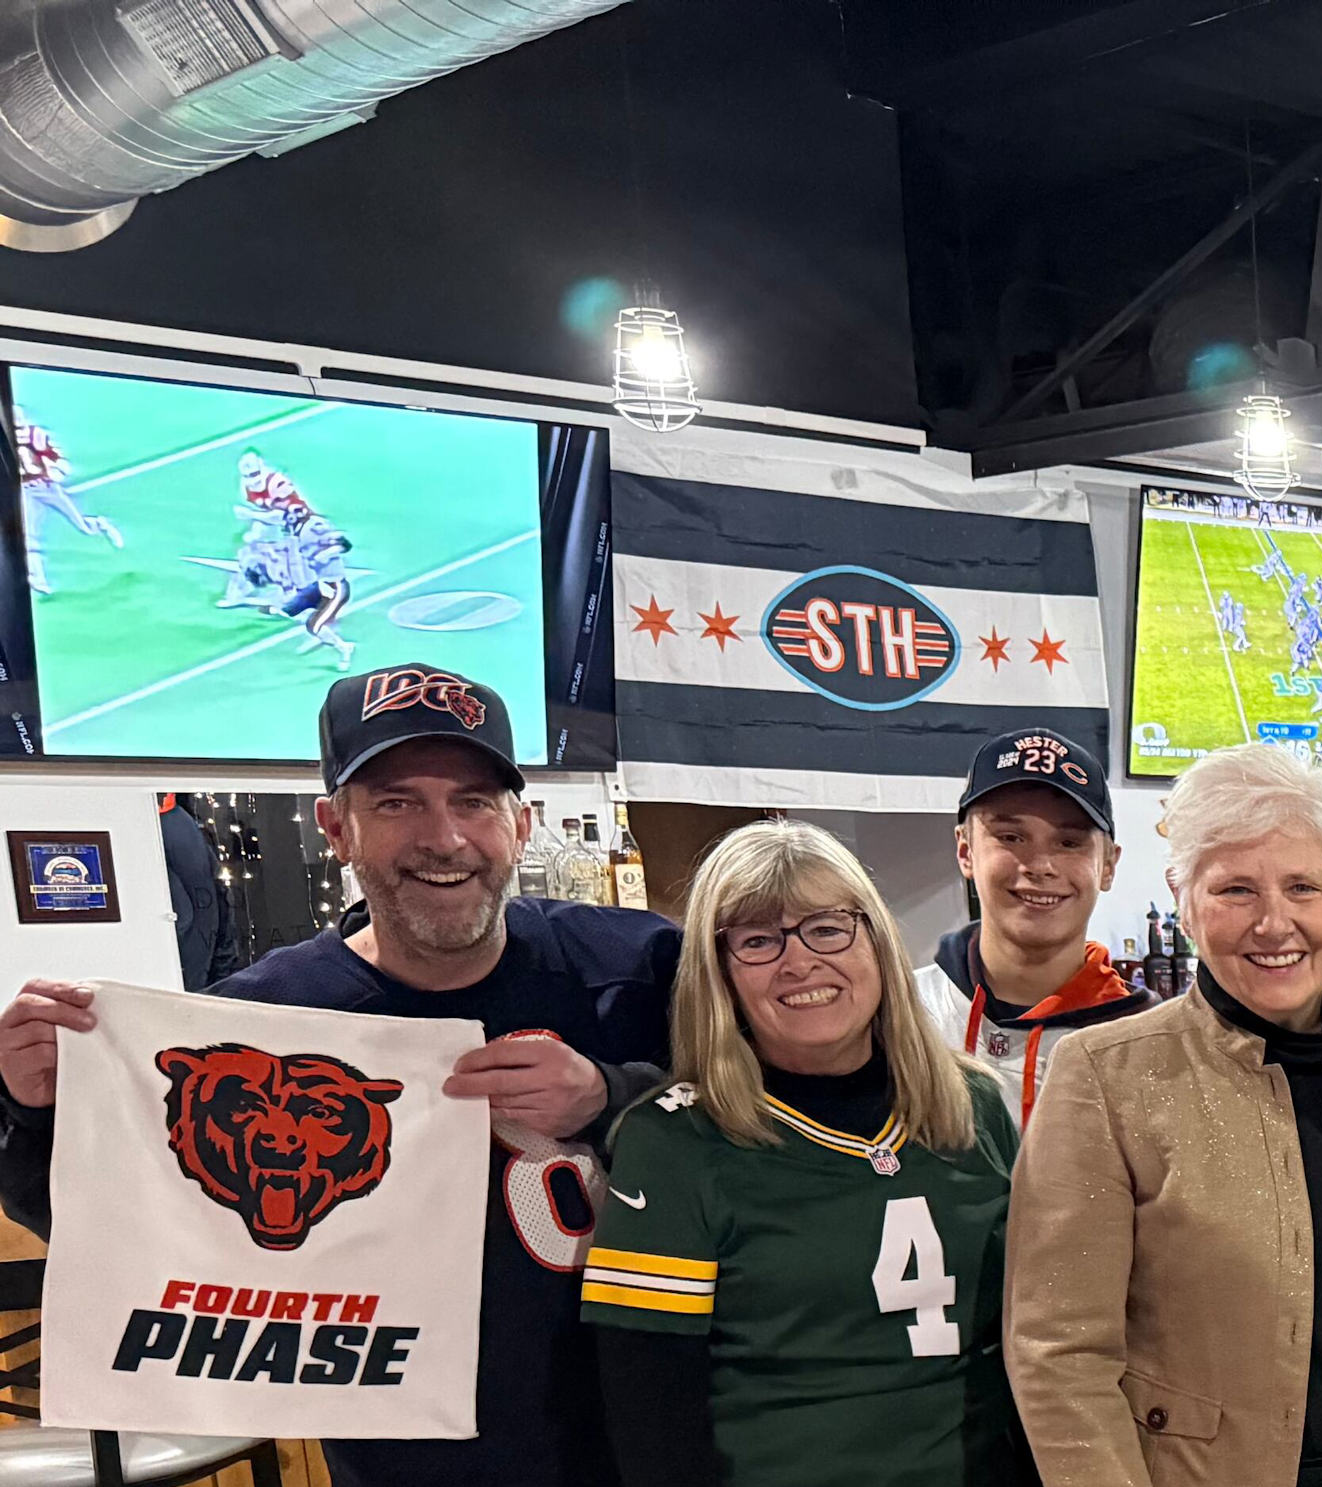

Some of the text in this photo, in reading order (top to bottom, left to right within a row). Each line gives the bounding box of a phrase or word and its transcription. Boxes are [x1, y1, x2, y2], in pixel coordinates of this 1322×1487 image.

[804, 597, 920, 680] STH
[1014, 736, 1068, 757] HESTER
[1023, 748, 1056, 774] 23
[875, 1157, 897, 1171] NFL
[872, 1196, 960, 1357] 4
[160, 1280, 380, 1323] FOURTH
[112, 1309, 420, 1386] PHASE
